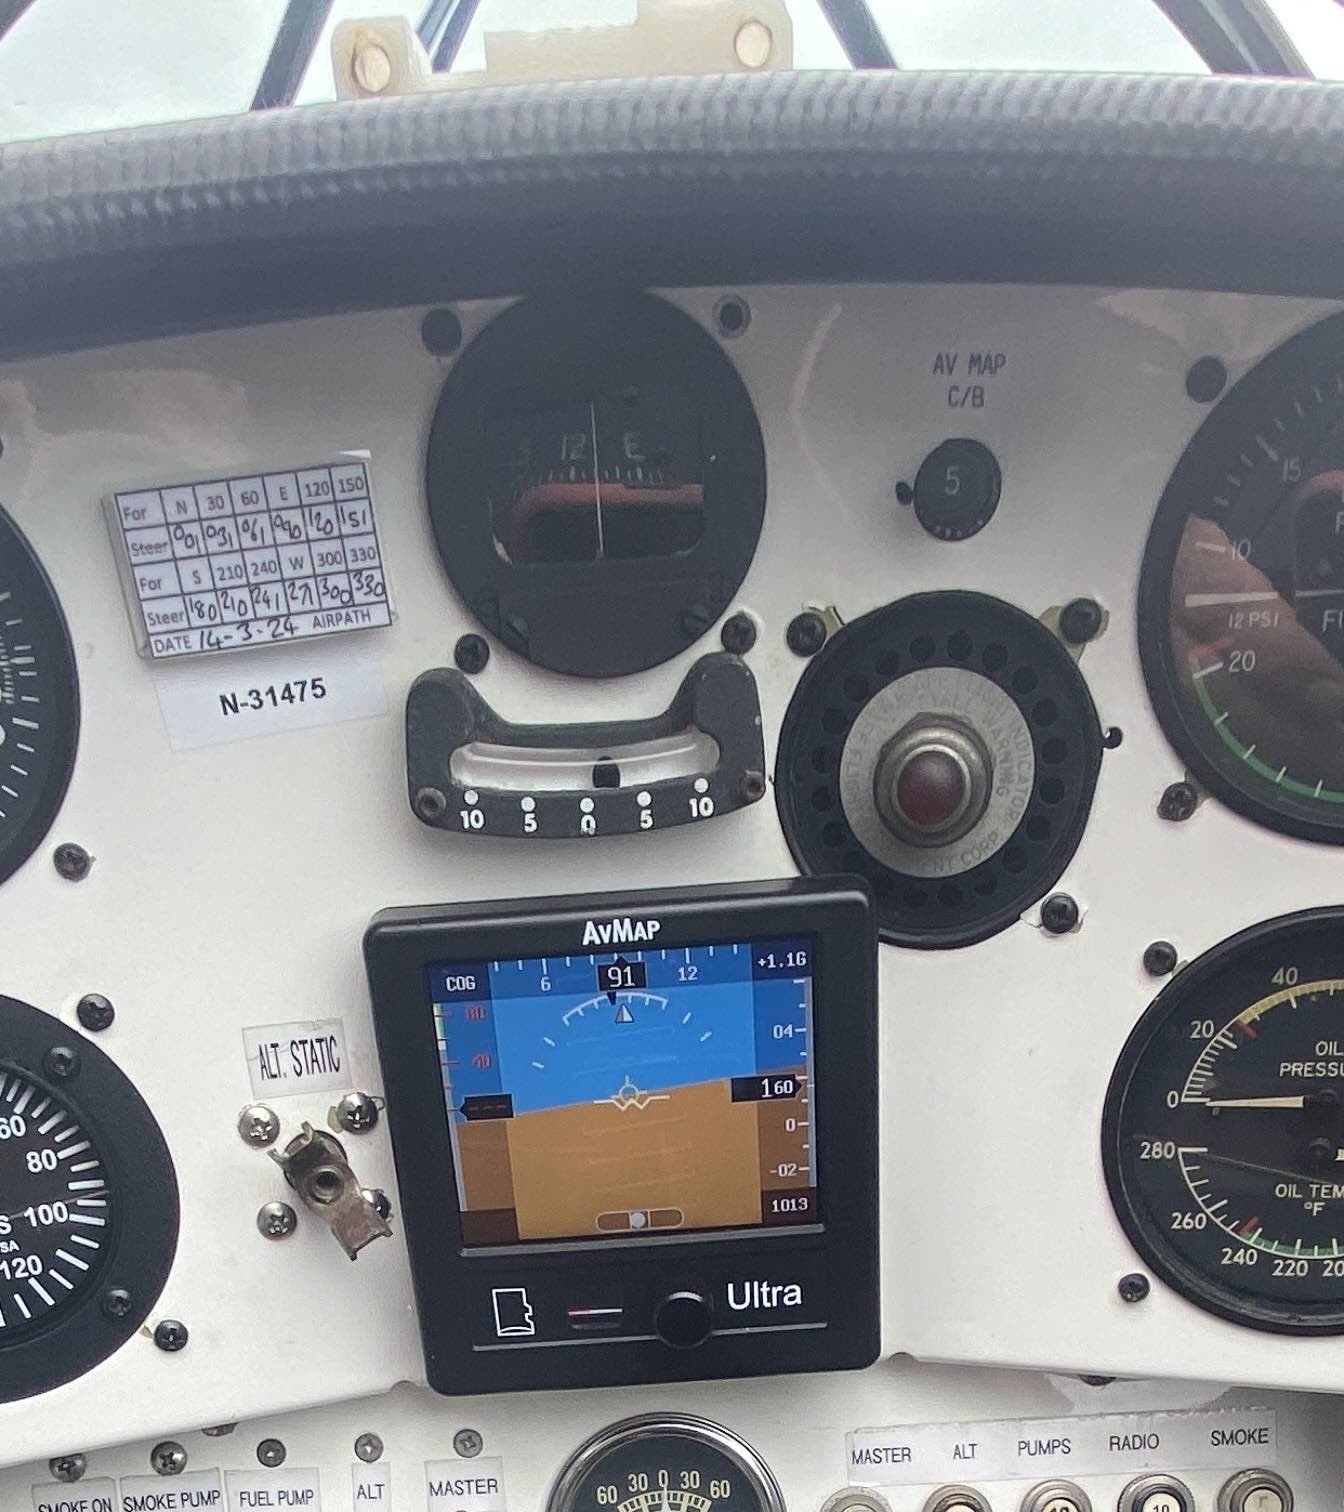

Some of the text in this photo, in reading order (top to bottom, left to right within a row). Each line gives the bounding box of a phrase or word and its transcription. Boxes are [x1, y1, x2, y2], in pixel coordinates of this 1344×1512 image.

[933, 353, 1006, 376] AV MAP
[947, 386, 985, 408] C/B
[123, 477, 364, 521] For N 30 60 E 120 150
[131, 541, 168, 557] Steer
[139, 547, 376, 591] For S 210 240 W 300 330
[147, 611, 184, 626] Steer
[154, 609, 371, 653] DATE AIRPATH
[220, 677, 326, 715] N-31475
[460, 810, 484, 829] 10
[524, 813, 537, 832] 5
[641, 809, 653, 829] 5
[689, 797, 714, 818] 10
[445, 966, 698, 992] COG 6 91 12
[1272, 968, 1298, 986] 40
[772, 1024, 793, 1039] 04
[1190, 1021, 1214, 1038] 20
[259, 1035, 340, 1080] ALT. STATIC
[1315, 1042, 1344, 1057] OIL
[761, 1079, 793, 1097] 160
[1167, 1091, 1179, 1109] 0
[1140, 1142, 1176, 1160] 280
[26, 1149, 57, 1173] 80
[1275, 1184, 1303, 1199] OIL
[24, 1201, 68, 1227] 100
[771, 1197, 808, 1214] 1013
[1171, 1212, 1206, 1230] 260
[1221, 1248, 1257, 1266] 240
[1272, 1259, 1308, 1278] 220
[727, 1281, 803, 1310] Ultra
[851, 1429, 1270, 1466] MASTER ALT PUMPS RADIO SMOKE
[356, 1483, 383, 1500] ALT
[429, 1479, 498, 1498] MASTER
[596, 1470, 730, 1505] 60 30 0 30 60
[123, 1490, 221, 1512] SMOKE PUMP
[239, 1488, 314, 1508] FUEL PUMP
